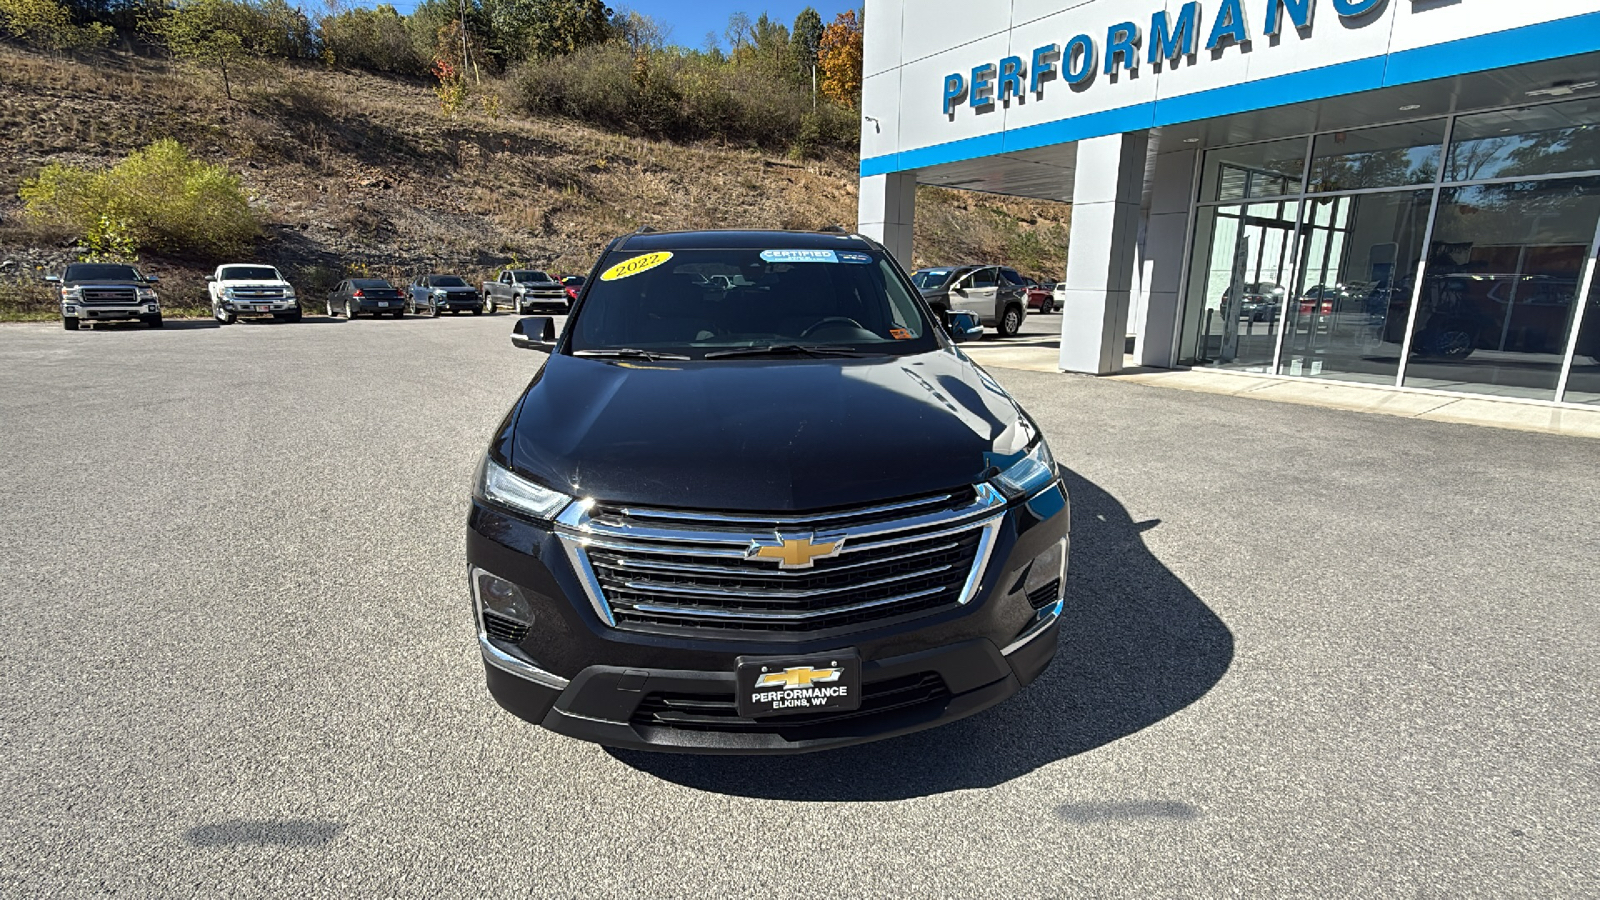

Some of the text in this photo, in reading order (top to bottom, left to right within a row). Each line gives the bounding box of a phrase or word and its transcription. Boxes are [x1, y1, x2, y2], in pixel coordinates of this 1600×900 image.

[942, 0, 1461, 118] PERFORMAN
[763, 250, 832, 258] CERTIFIED
[616, 254, 660, 277] 2022
[751, 686, 848, 703] PERFORMANCE
[772, 697, 828, 709] ELKINS, WV
